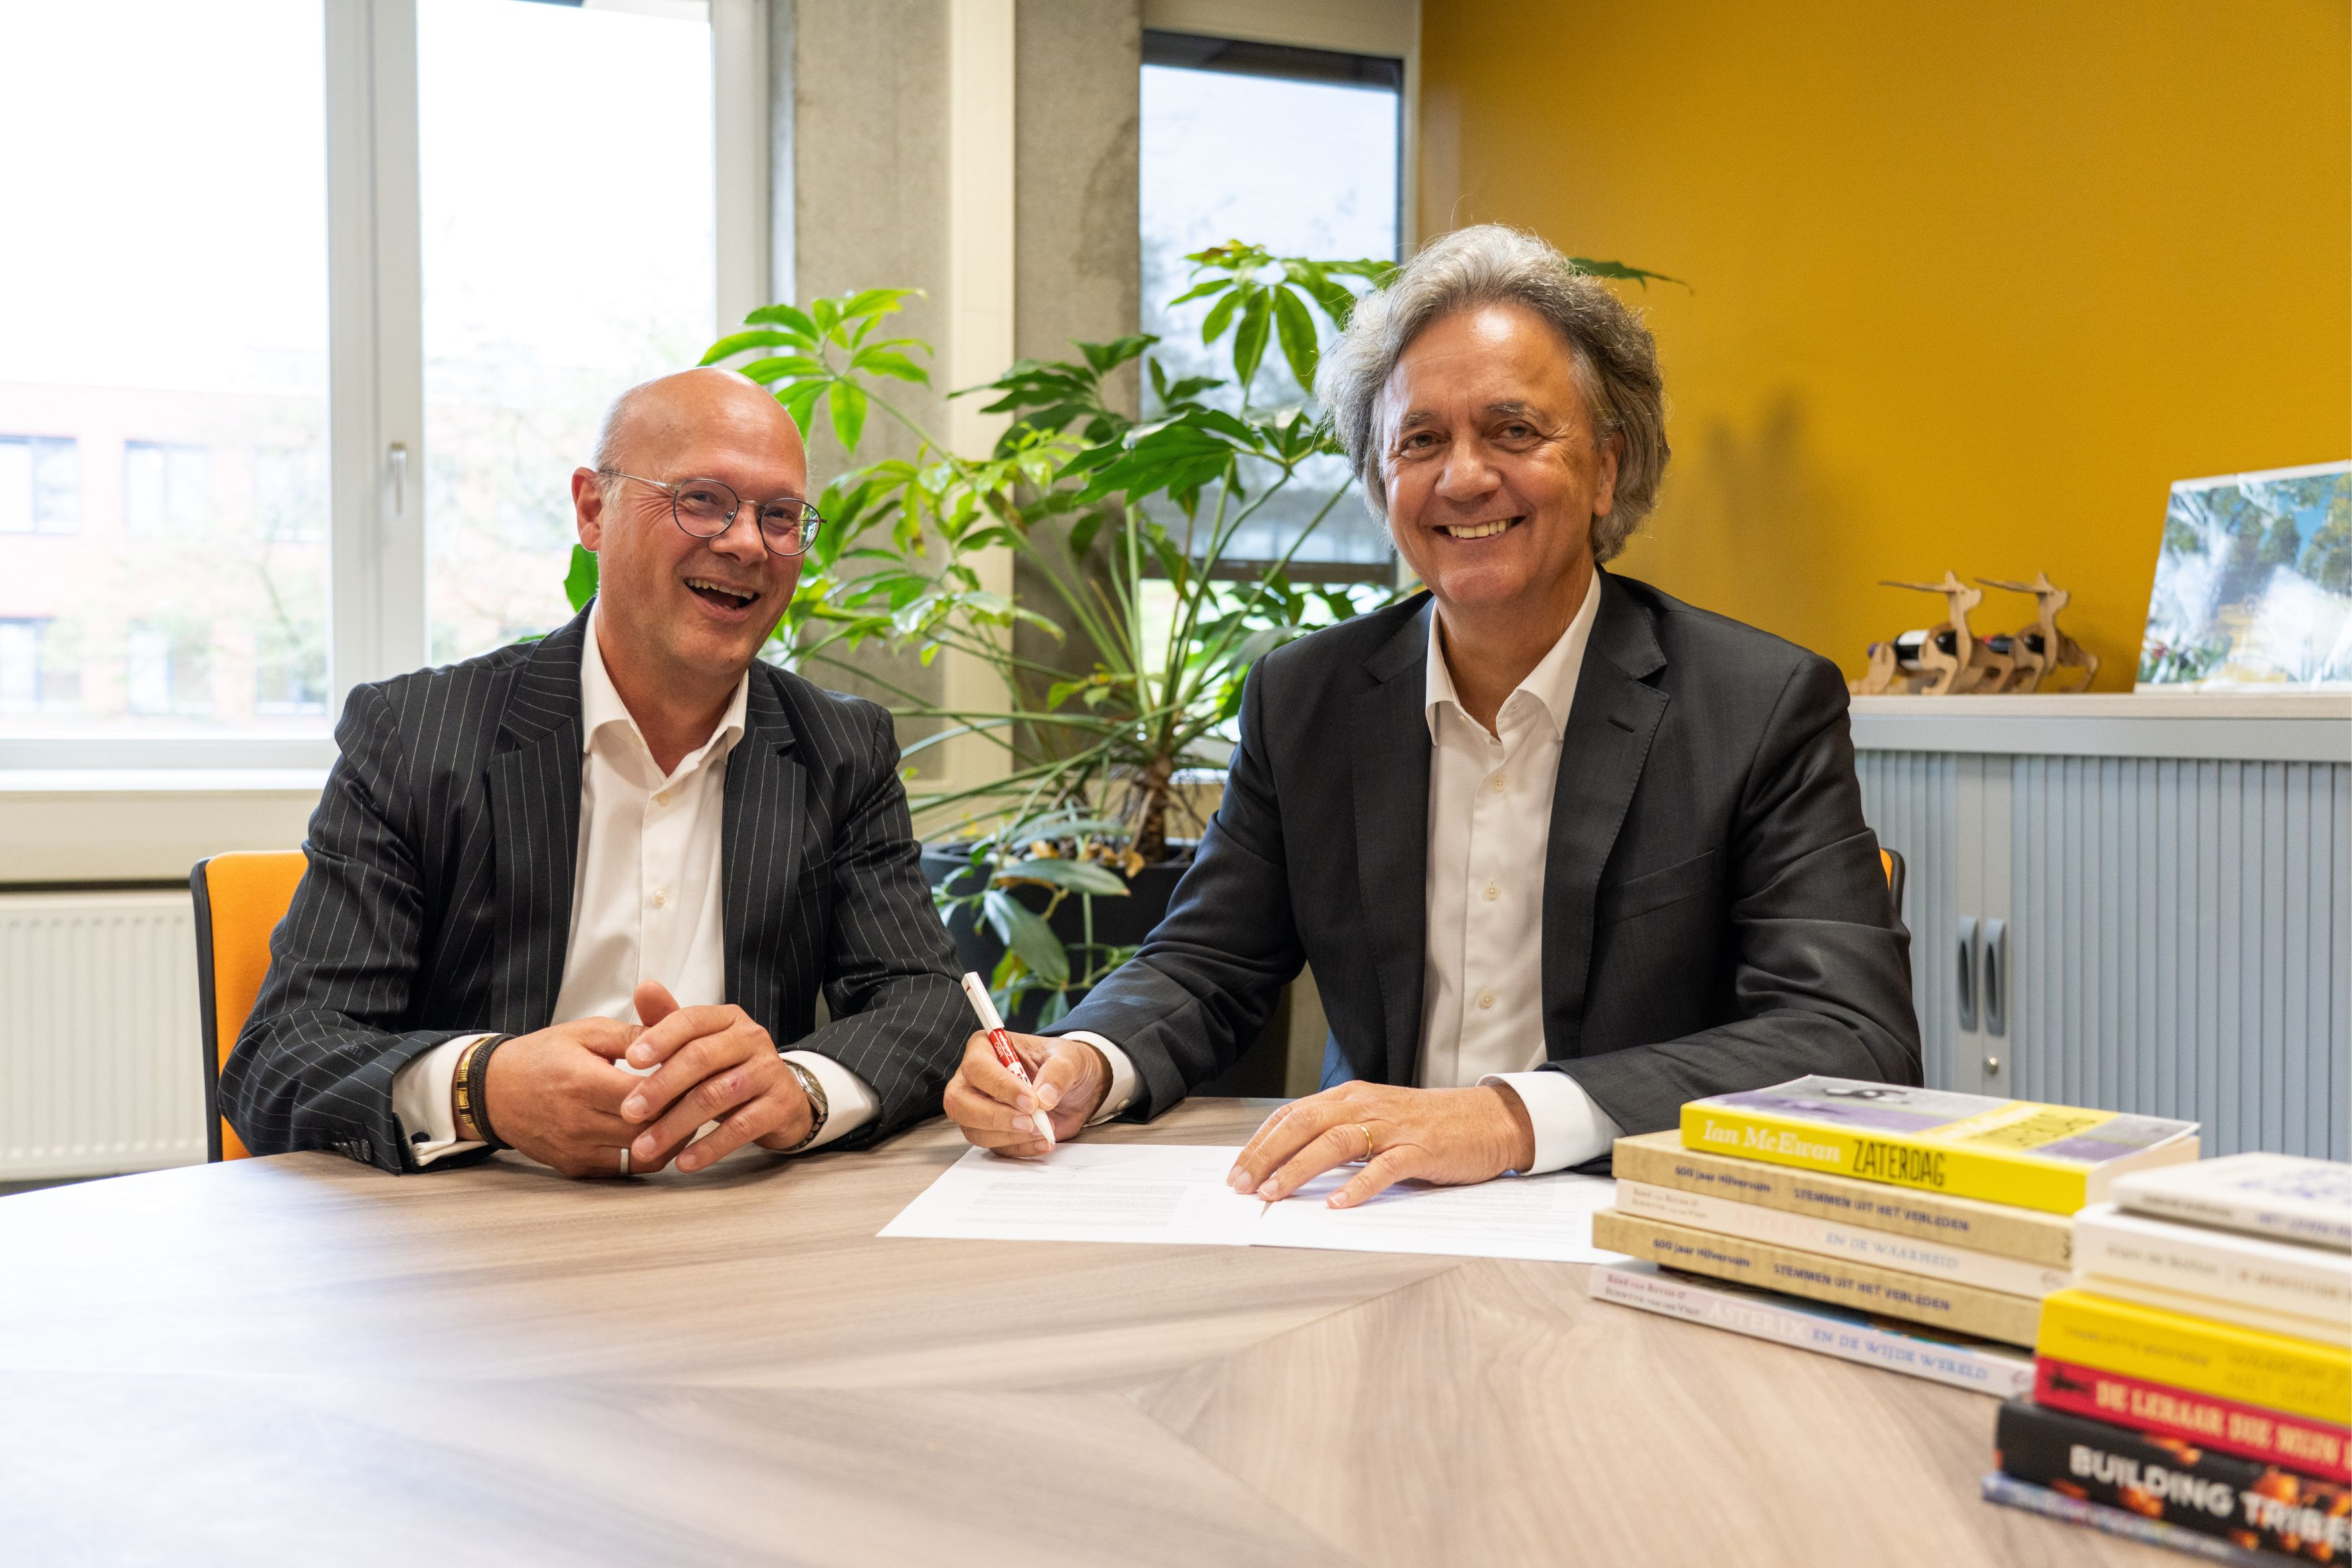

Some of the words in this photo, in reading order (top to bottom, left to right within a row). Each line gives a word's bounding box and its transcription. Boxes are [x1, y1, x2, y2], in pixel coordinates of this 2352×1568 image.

[995, 1042, 1005, 1058] MBO
[1702, 1120, 1739, 1145] Ian
[1743, 1126, 1842, 1163] McEwan
[1852, 1139, 1945, 1187] ZATERDAG
[1675, 1165, 1694, 1177] 600
[1696, 1169, 1715, 1181] jaar
[1718, 1174, 1771, 1193] Hilversum
[1794, 1187, 1850, 1208] STEMMEN
[1854, 1201, 1874, 1213] UIT
[1877, 1205, 1900, 1217] HET
[1904, 1210, 1970, 1231] VERLEDEN
[1653, 1238, 1672, 1250] 600
[1674, 1242, 1694, 1254] jaar
[1696, 1248, 1750, 1266] Hilversum
[1825, 1232, 1844, 1244] EN
[1850, 1236, 1868, 1250] DE
[1773, 1262, 1831, 1284] STEMMEN
[1834, 1277, 1854, 1289] UIT
[1857, 1282, 1881, 1296] HET
[1884, 1288, 1950, 1311] VERLEDEN
[1707, 1300, 1808, 1339] ASTERIX
[1812, 1328, 1834, 1342] EN
[1838, 1333, 1859, 1349] DE
[1864, 1339, 1915, 1362] WIJDE
[1920, 1353, 1990, 1380] WERELD
[2096, 1379, 2126, 1413] DE
[2130, 1388, 2224, 1437] LERAAR
[2228, 1412, 2272, 1450] DIE
[2068, 1443, 2236, 1518] BUILDING
[2238, 1490, 2352, 1554] TRIBE
